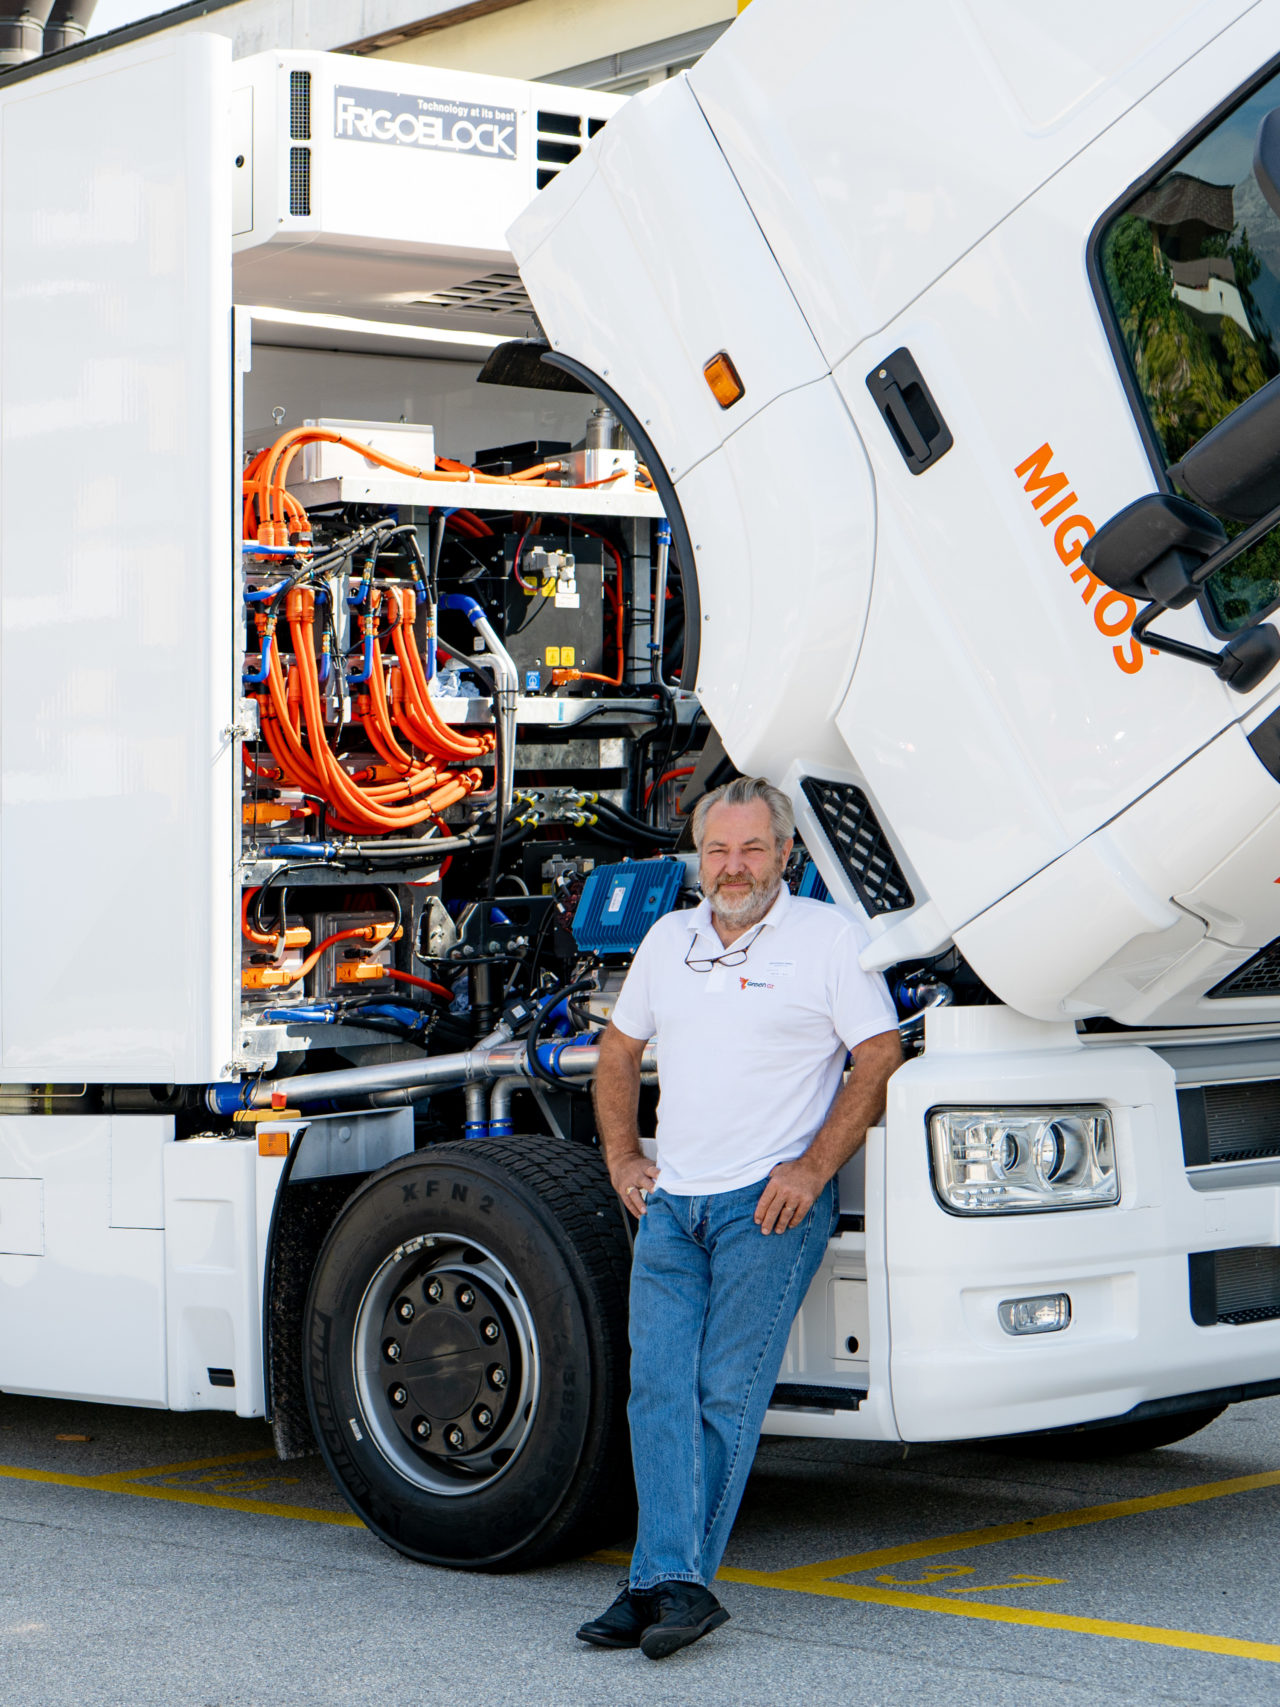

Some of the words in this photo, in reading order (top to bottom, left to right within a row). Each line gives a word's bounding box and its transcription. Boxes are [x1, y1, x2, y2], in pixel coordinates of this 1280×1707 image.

[417, 99, 469, 117] Technology
[470, 108, 480, 117] at
[481, 108, 493, 119] its
[495, 108, 515, 122] best
[336, 96, 516, 156] FRIGOBLOCK
[874, 1564, 1069, 1594] 37
